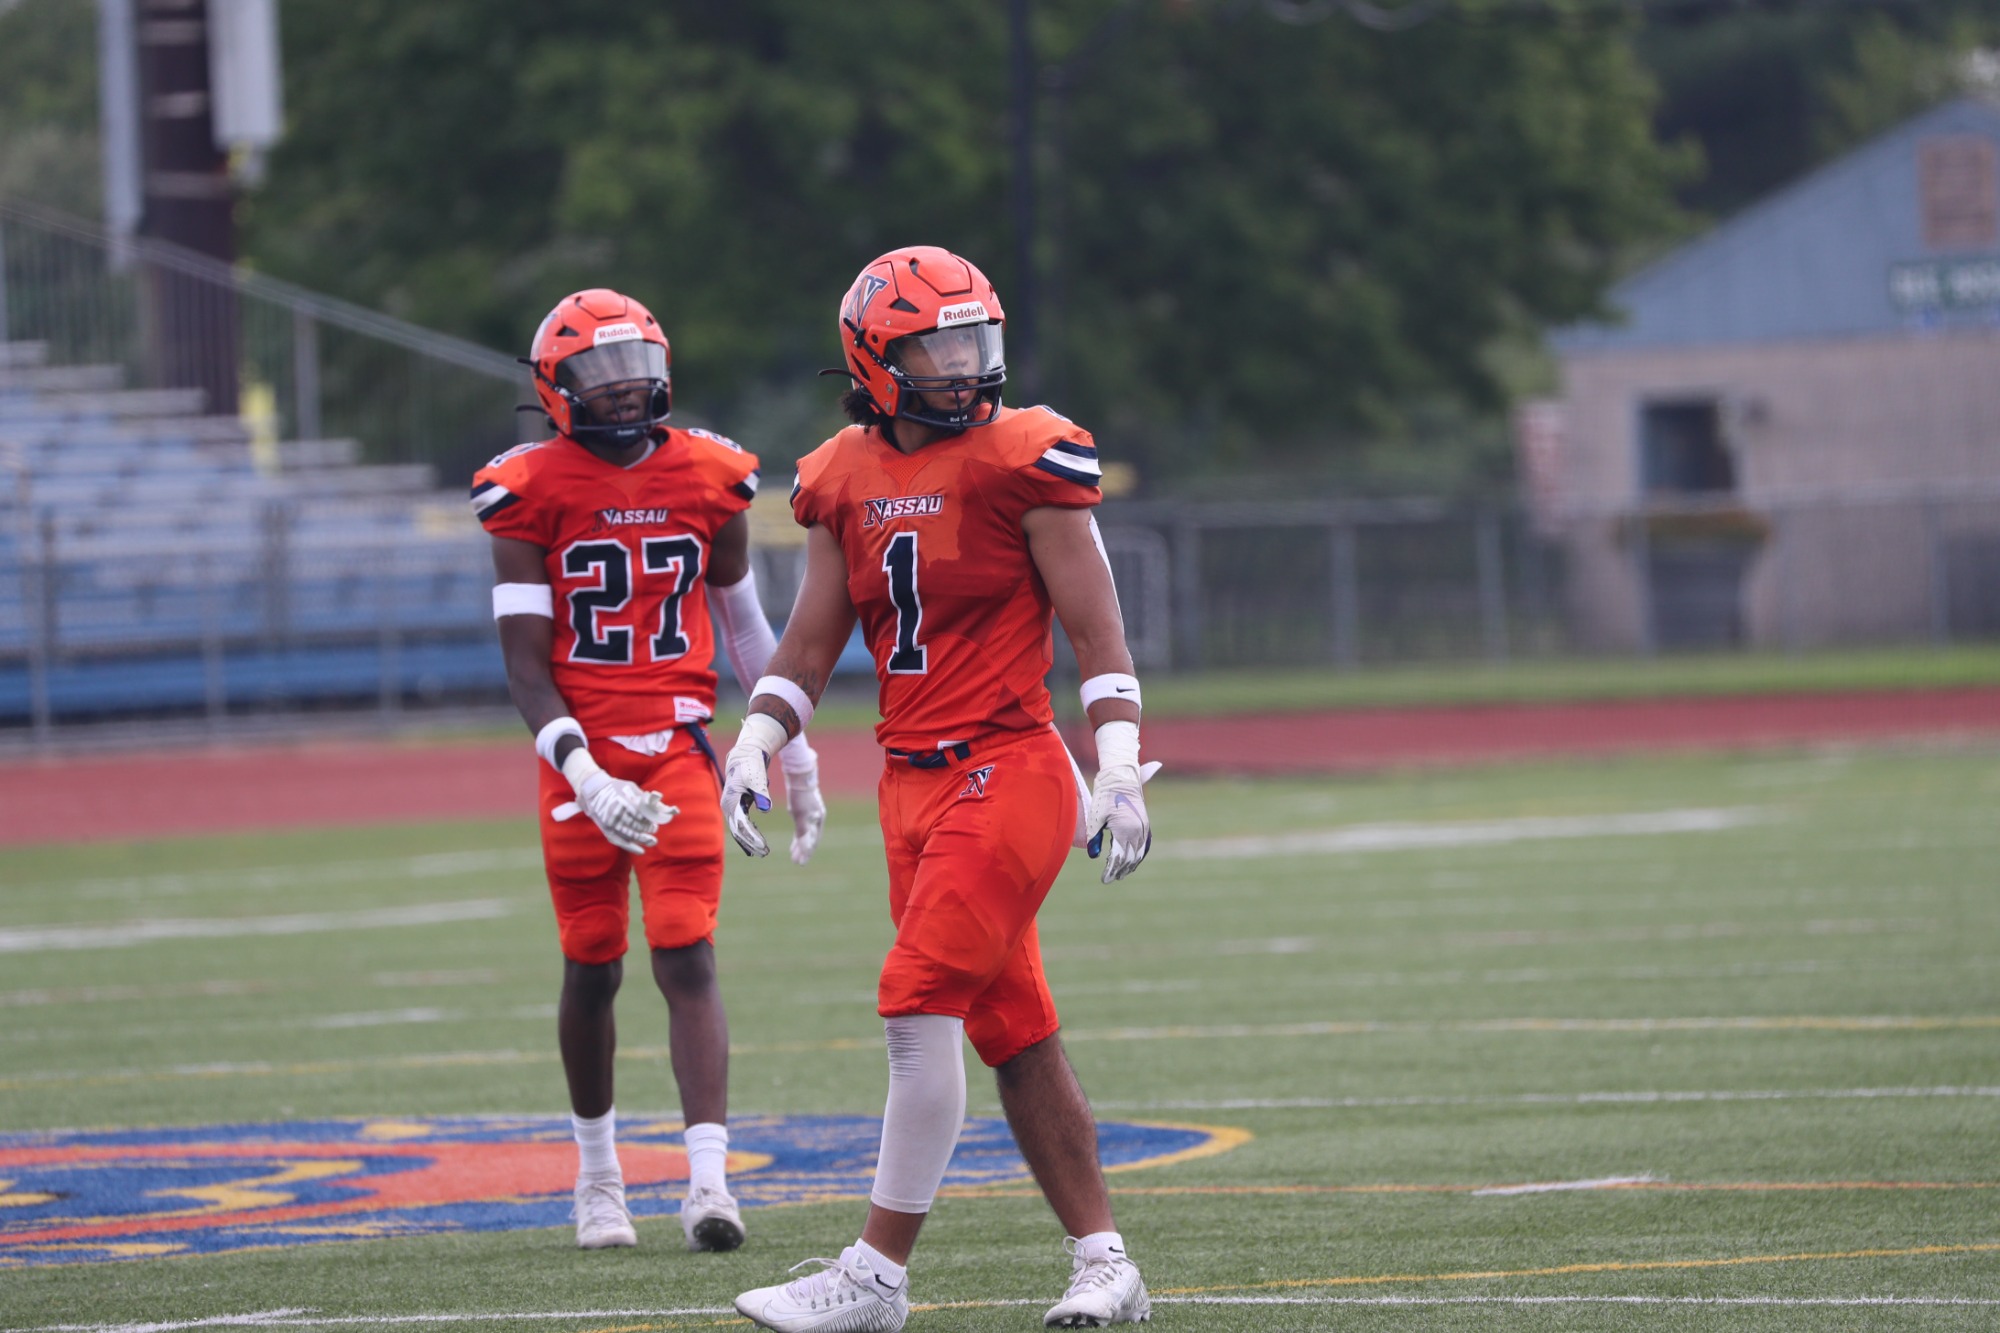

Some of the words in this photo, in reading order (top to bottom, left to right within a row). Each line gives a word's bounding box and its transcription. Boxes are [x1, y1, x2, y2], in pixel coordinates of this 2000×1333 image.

[943, 306, 985, 322] Riddell
[598, 327, 638, 340] Riddell
[591, 507, 670, 531] NASSAU
[863, 494, 945, 529] NASSAU
[561, 533, 703, 665] 27
[882, 531, 928, 674] 1
